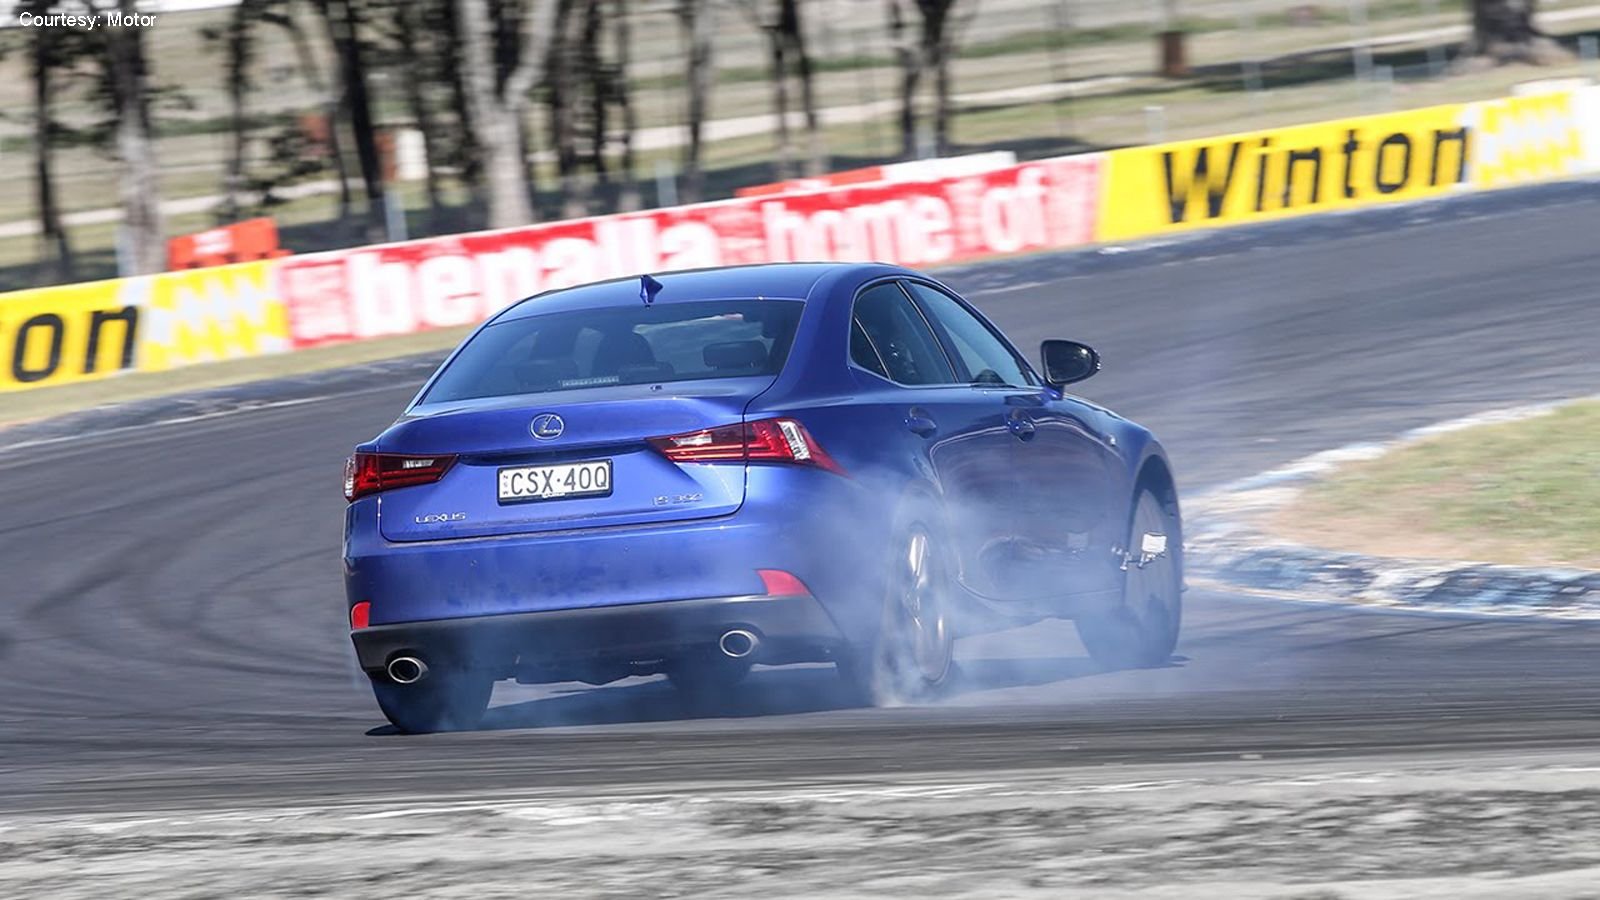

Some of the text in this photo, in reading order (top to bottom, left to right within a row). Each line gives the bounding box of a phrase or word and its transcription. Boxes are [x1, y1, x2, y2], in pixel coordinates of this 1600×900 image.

[1162, 125, 1470, 224] Winton
[349, 165, 1054, 337] benalla home of
[415, 511, 466, 524] LEXUS
